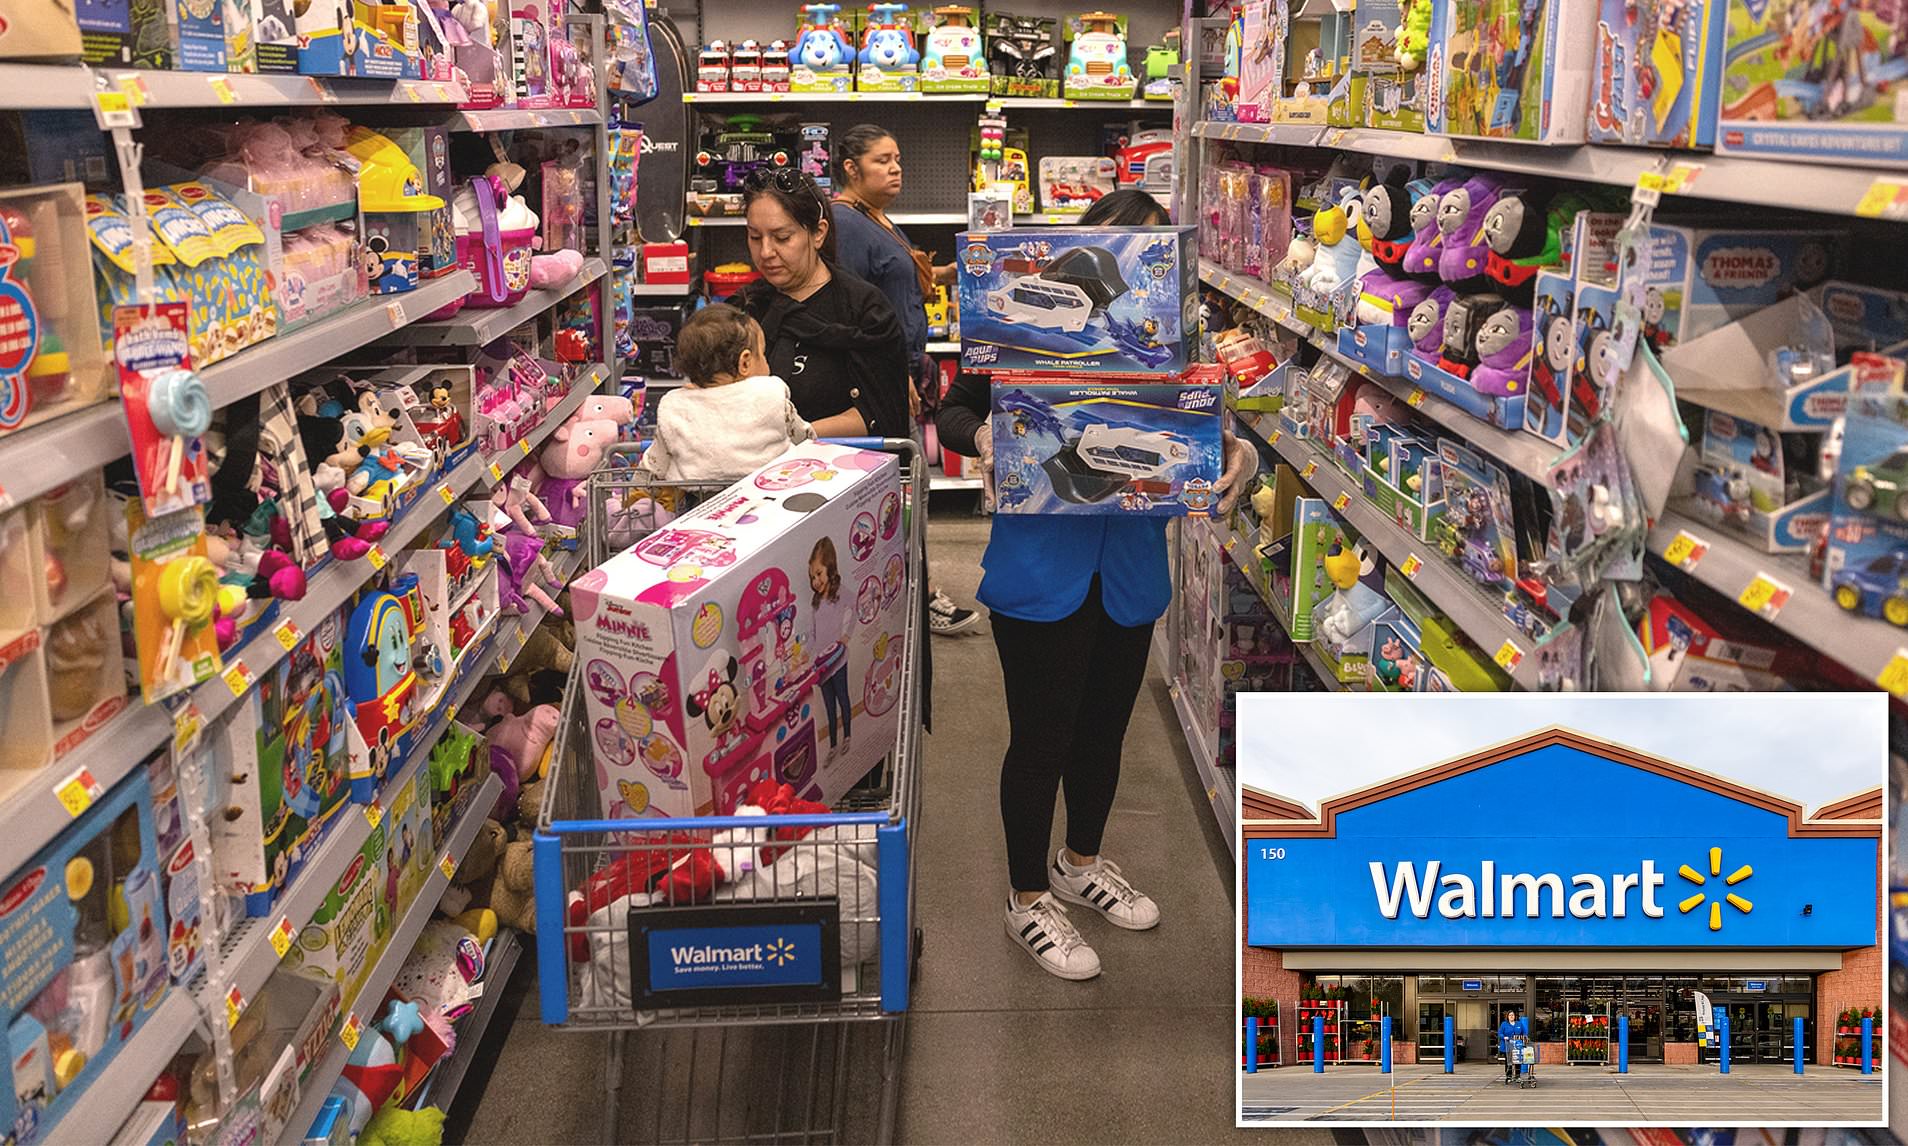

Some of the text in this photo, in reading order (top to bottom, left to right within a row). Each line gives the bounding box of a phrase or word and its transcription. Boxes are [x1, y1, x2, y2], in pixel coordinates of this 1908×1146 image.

[1710, 256, 1775, 270] THOMAS
[1724, 268, 1768, 279] FRIENDS
[964, 345, 993, 357] AQUA
[970, 353, 998, 365] PUPS
[596, 613, 650, 640] MINNIE
[1260, 847, 1286, 860] 150
[1368, 859, 1665, 919] Walmart
[670, 943, 763, 966] Walmart
[674, 966, 693, 974] Save
[721, 963, 738, 971] Live
[738, 963, 765, 971] better.
